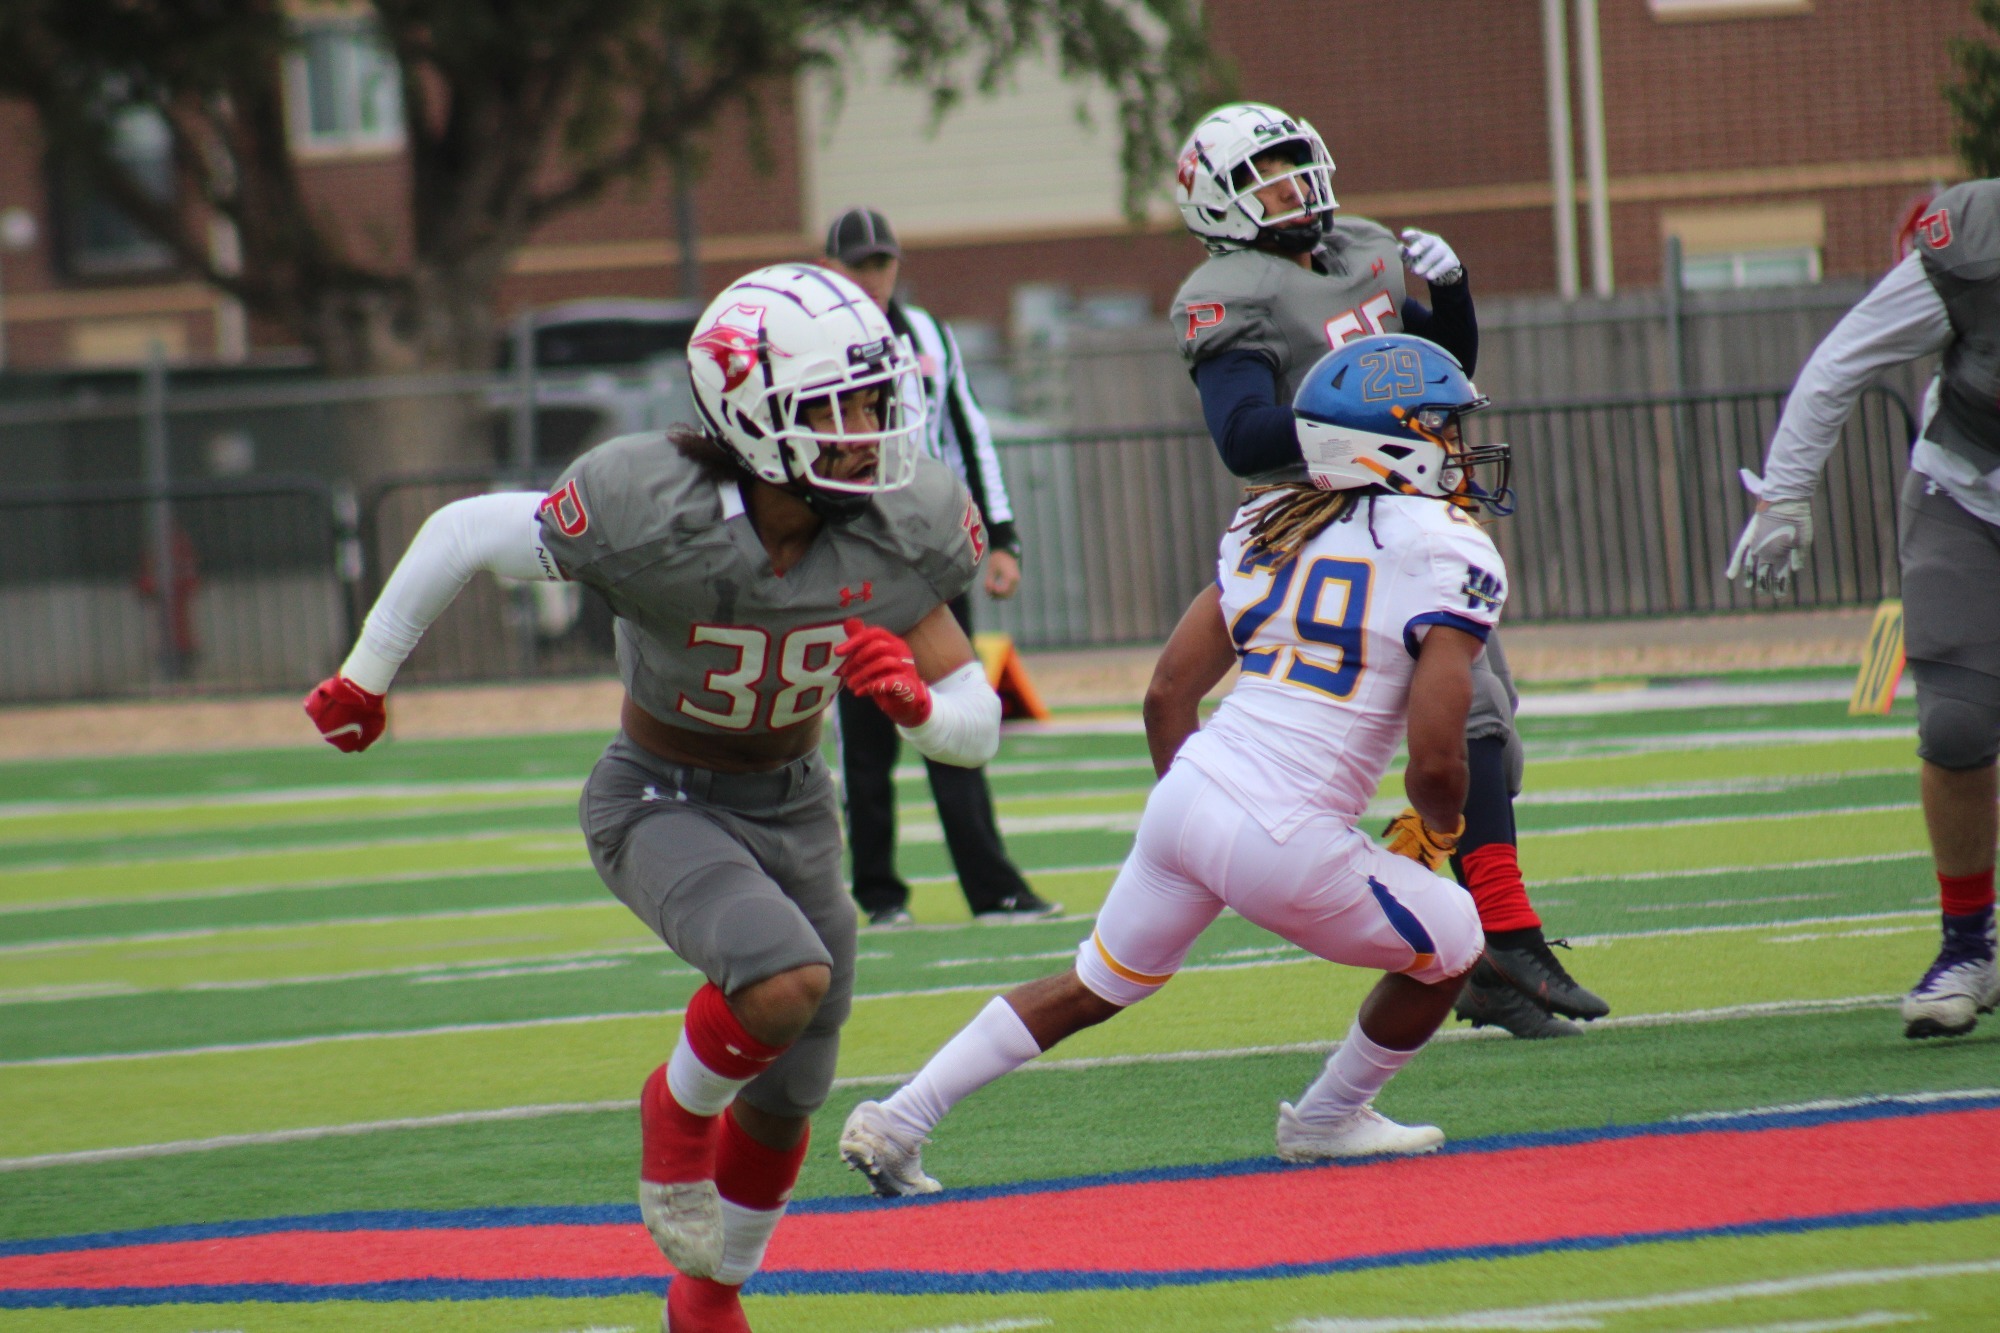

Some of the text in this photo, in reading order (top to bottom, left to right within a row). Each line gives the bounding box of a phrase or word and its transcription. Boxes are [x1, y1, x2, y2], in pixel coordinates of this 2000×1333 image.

[1185, 302, 1226, 341] P
[1360, 349, 1424, 402] 29
[540, 478, 588, 537] P
[1230, 542, 1376, 702] 29
[677, 621, 848, 732] 38
